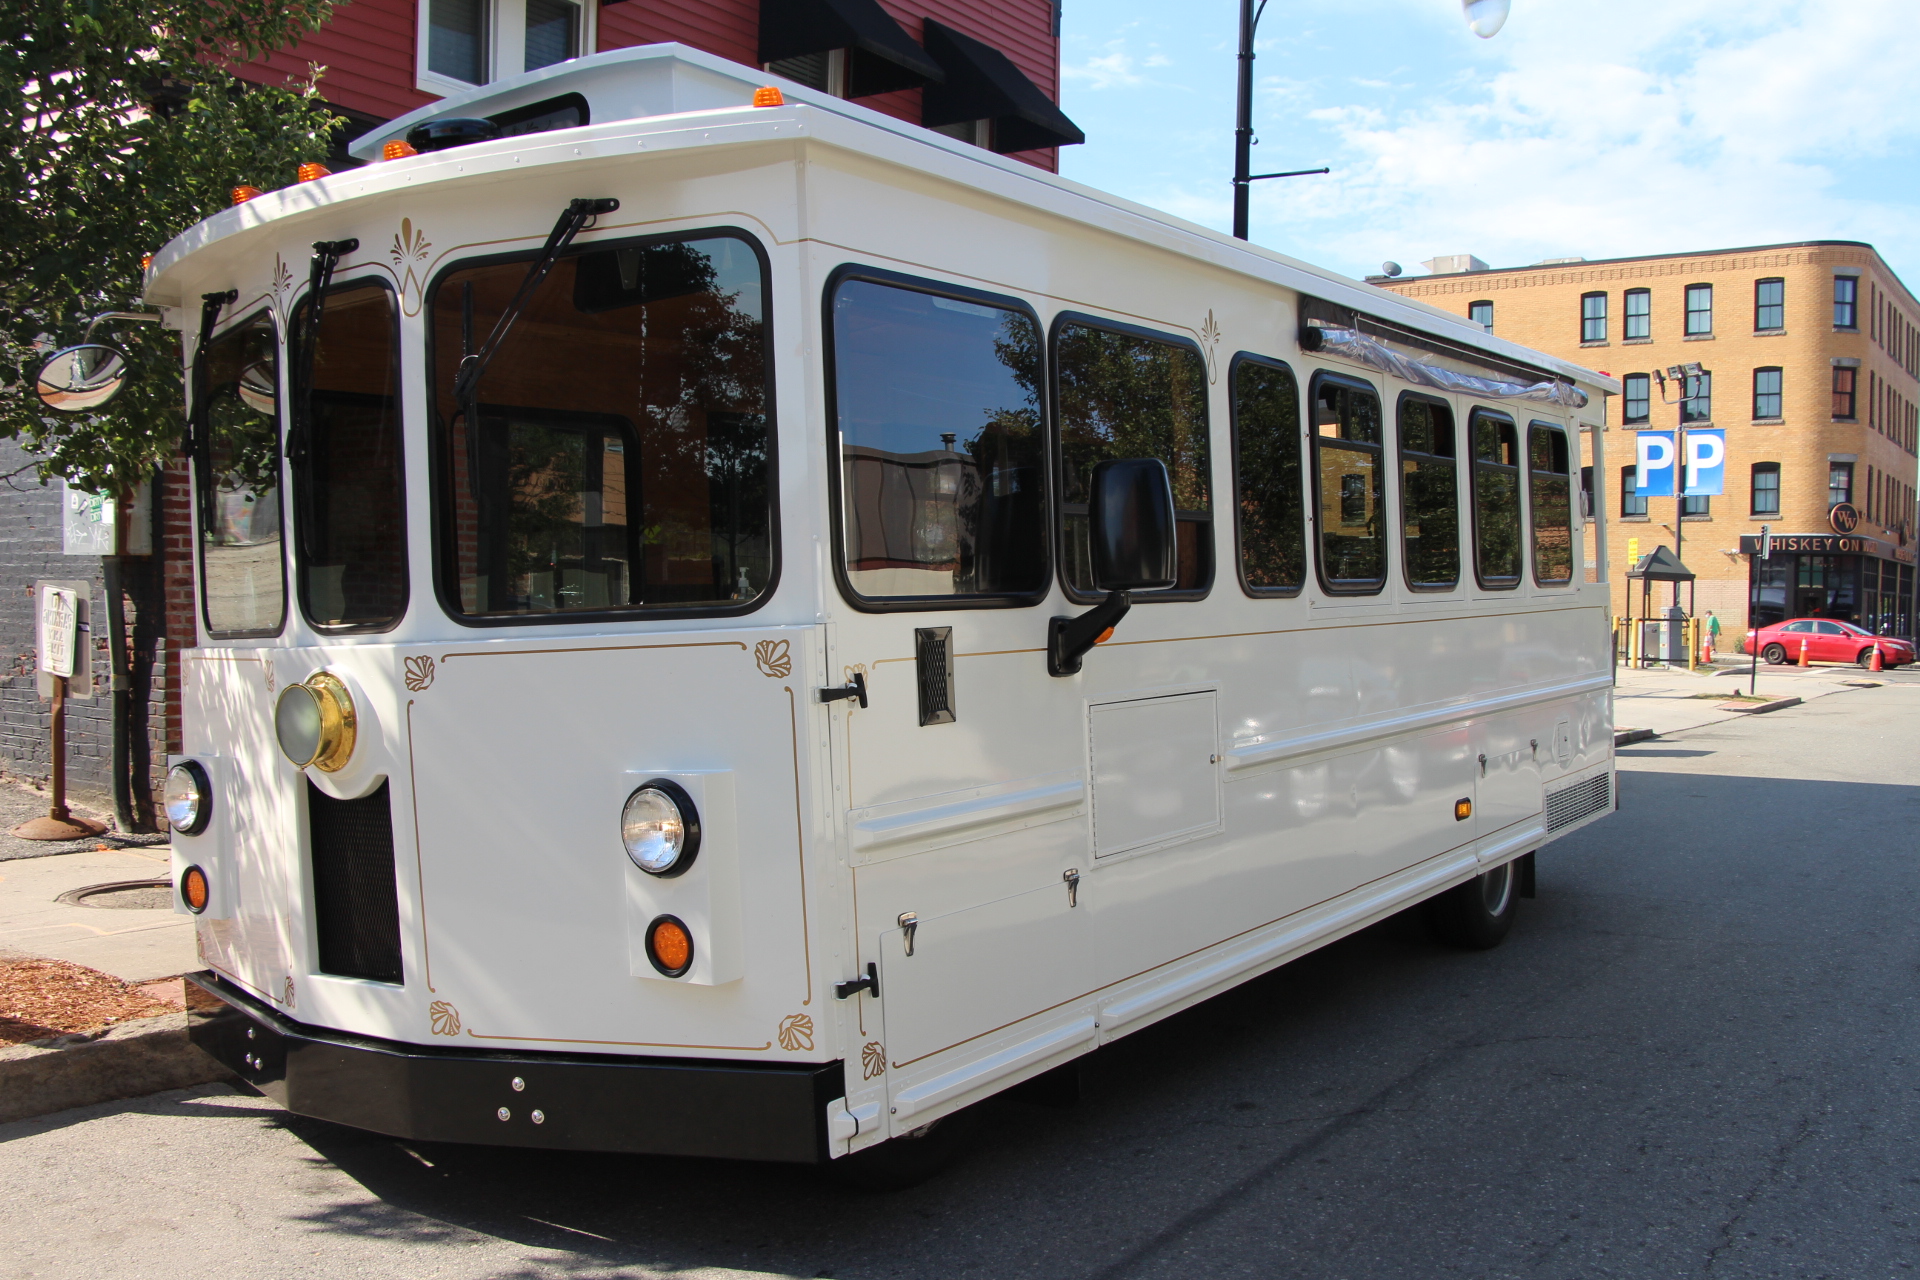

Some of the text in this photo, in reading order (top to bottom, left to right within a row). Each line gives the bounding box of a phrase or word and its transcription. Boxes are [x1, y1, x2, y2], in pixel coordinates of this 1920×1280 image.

[1636, 435, 1674, 488] P
[1685, 433, 1724, 487] P
[1839, 538, 1859, 551] ON
